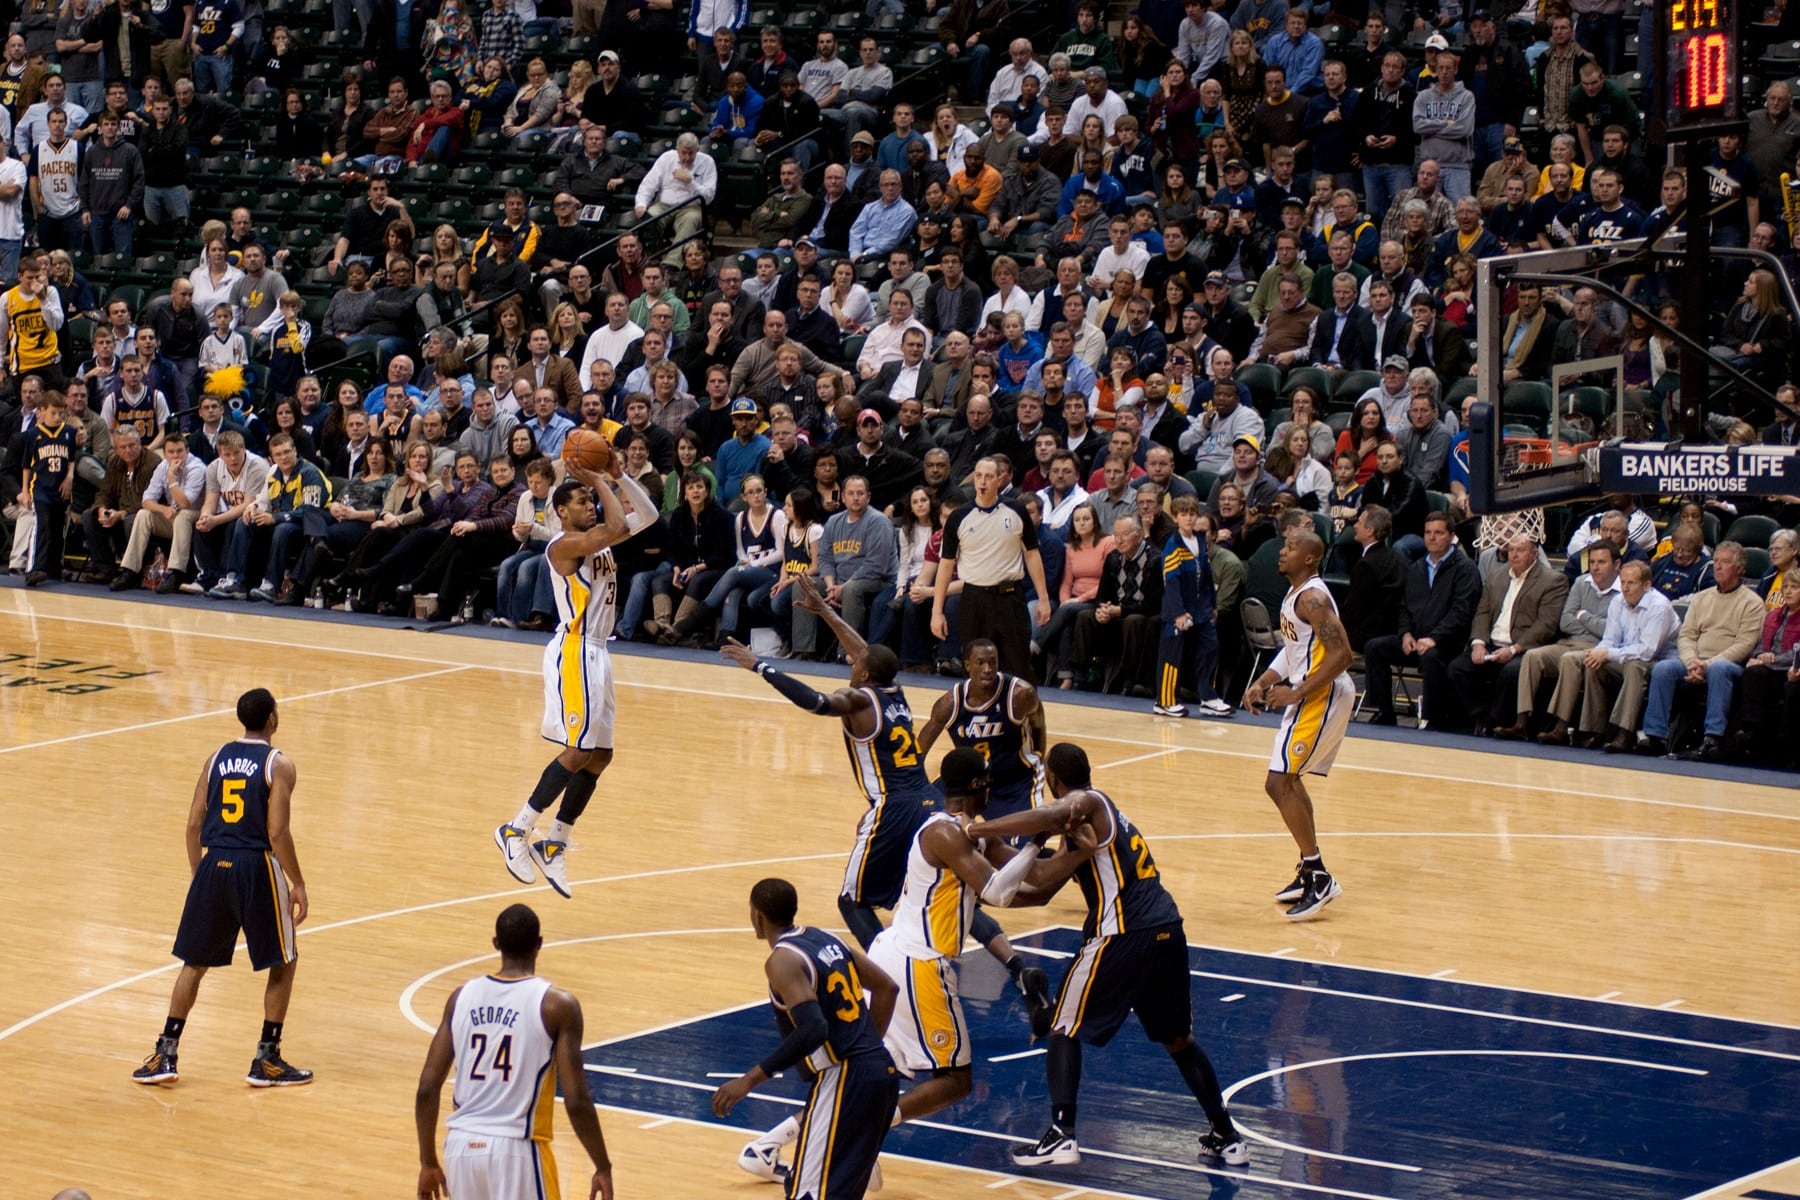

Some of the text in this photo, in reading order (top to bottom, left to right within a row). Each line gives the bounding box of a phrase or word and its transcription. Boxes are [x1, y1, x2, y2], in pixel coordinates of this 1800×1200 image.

[1686, 33, 1728, 109] 10
[1426, 102, 1463, 119] BUTLER
[41, 161, 76, 179] PACERS
[53, 178, 68, 193] 55
[29, 331, 46, 349] 7
[38, 443, 69, 460] INDIANA
[47, 457, 62, 473] 33
[1622, 455, 1785, 477] BANKERS LIFE
[1658, 477, 1748, 492] FIELDHOUSE
[957, 715, 1005, 738] JAZZ
[218, 757, 258, 777] HARRIS
[221, 778, 247, 824] 5
[470, 1005, 520, 1028] GEORGE
[469, 1033, 513, 1082] 24
